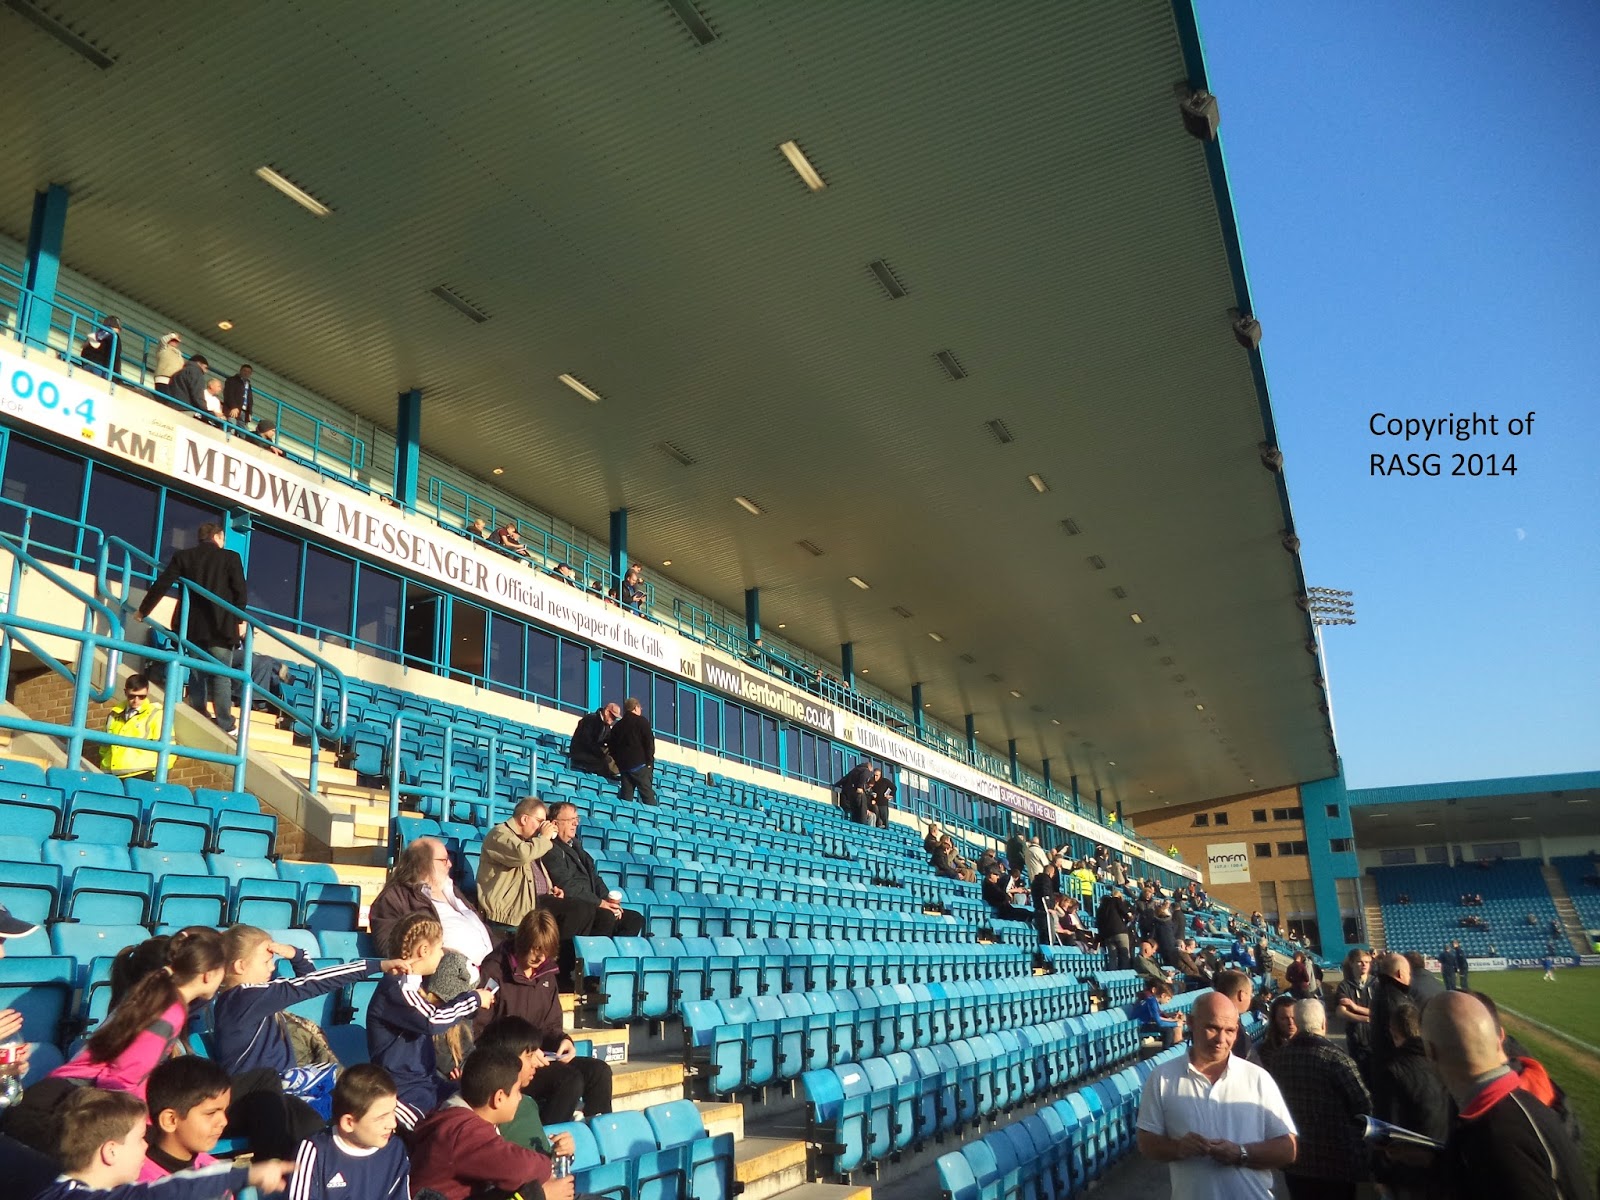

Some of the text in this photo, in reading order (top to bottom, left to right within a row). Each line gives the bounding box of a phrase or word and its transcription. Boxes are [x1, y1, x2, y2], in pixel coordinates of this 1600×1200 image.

[0, 361, 96, 425] 00.4
[107, 422, 157, 464] KM
[183, 438, 664, 660] MEDWAY MESSENGER Official newspaper of the Gills
[680, 658, 696, 678] KM
[705, 663, 832, 732] www.kentonline.co.uk
[843, 727, 853, 742] KM
[857, 726, 926, 769] MEDWAY MESSENGER
[1000, 790, 1034, 814] SUPPORTING
[1034, 803, 1044, 817] THE
[1507, 957, 1539, 966] JOHN
